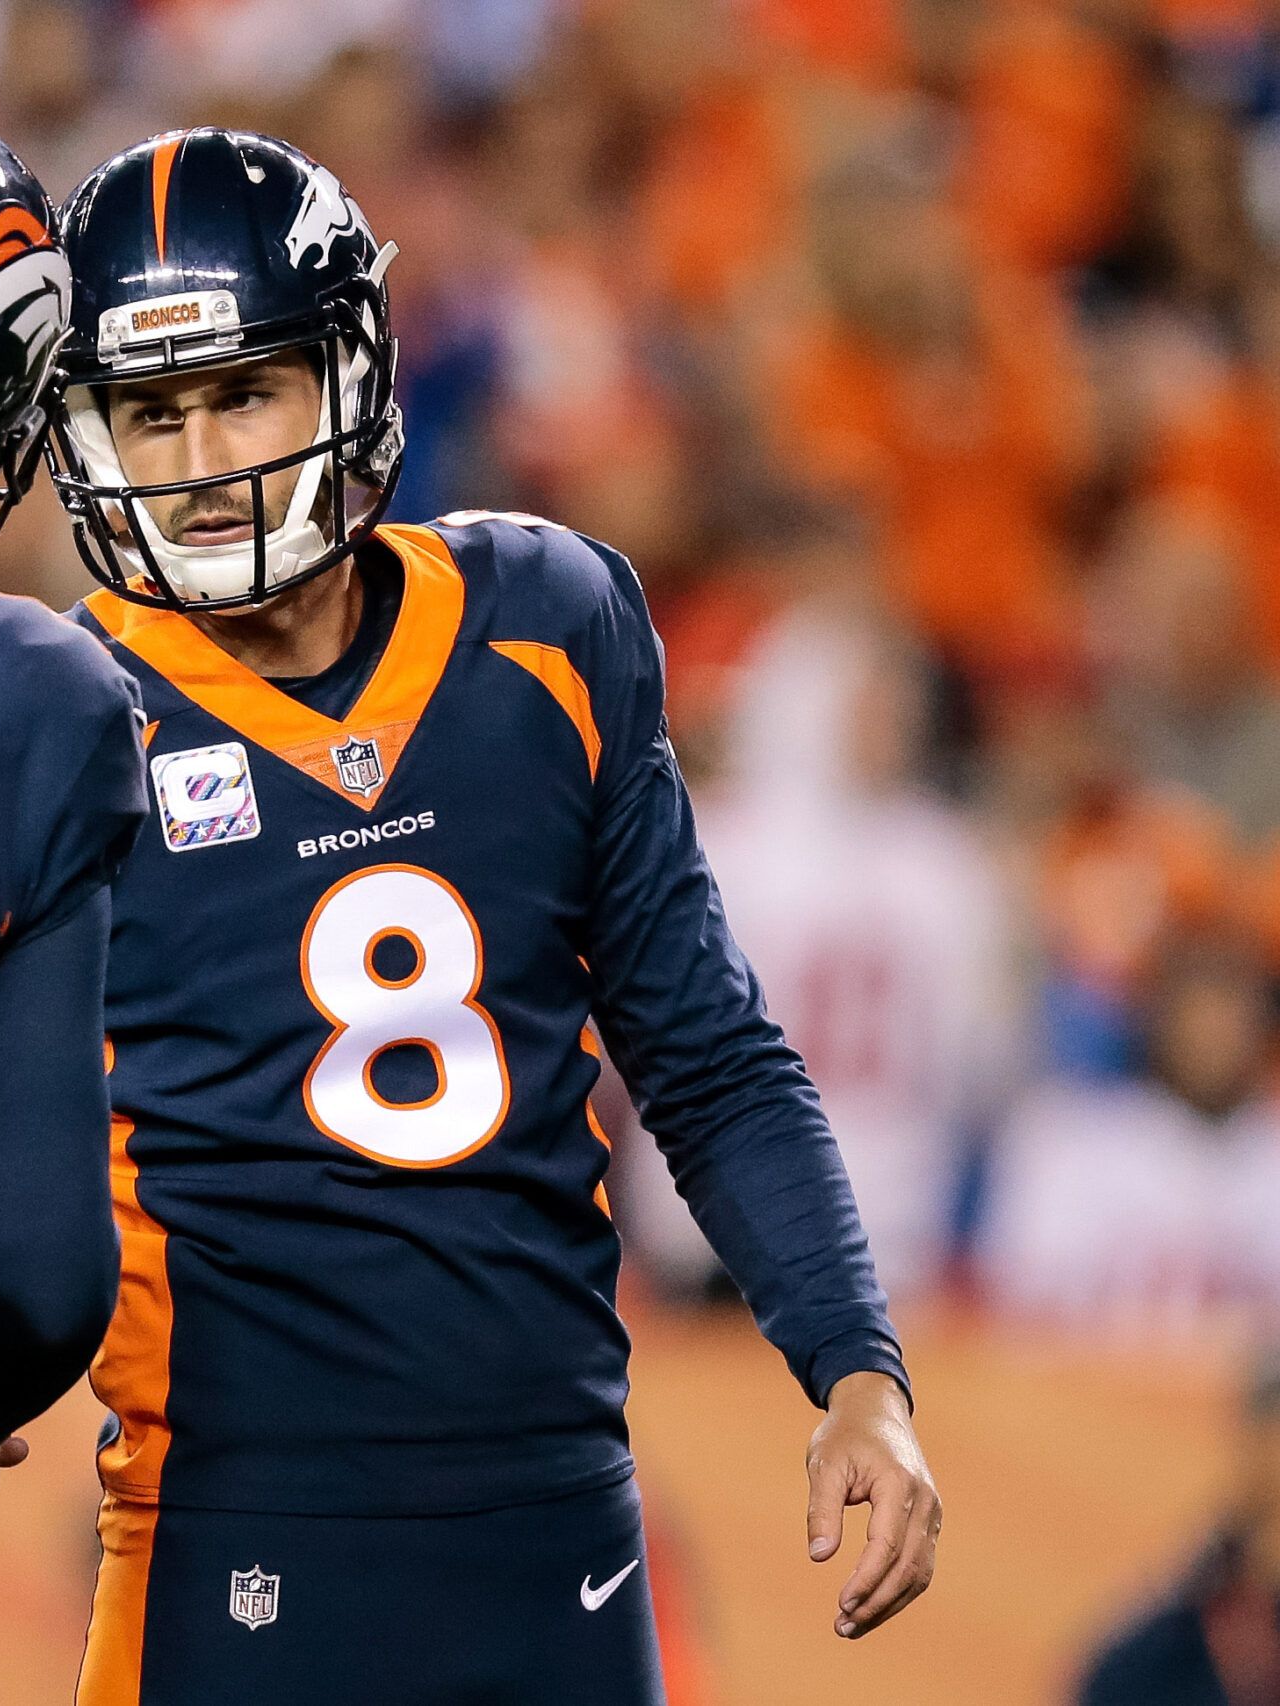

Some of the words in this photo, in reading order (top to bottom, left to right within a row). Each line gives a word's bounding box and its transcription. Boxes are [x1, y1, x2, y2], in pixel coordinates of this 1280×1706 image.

[131, 302, 201, 332] BRONCOS
[162, 752, 245, 823] C
[344, 761, 378, 786] NFL
[297, 810, 436, 858] BRONCOS
[299, 862, 511, 1169] 8
[238, 1593, 270, 1617] NFL
